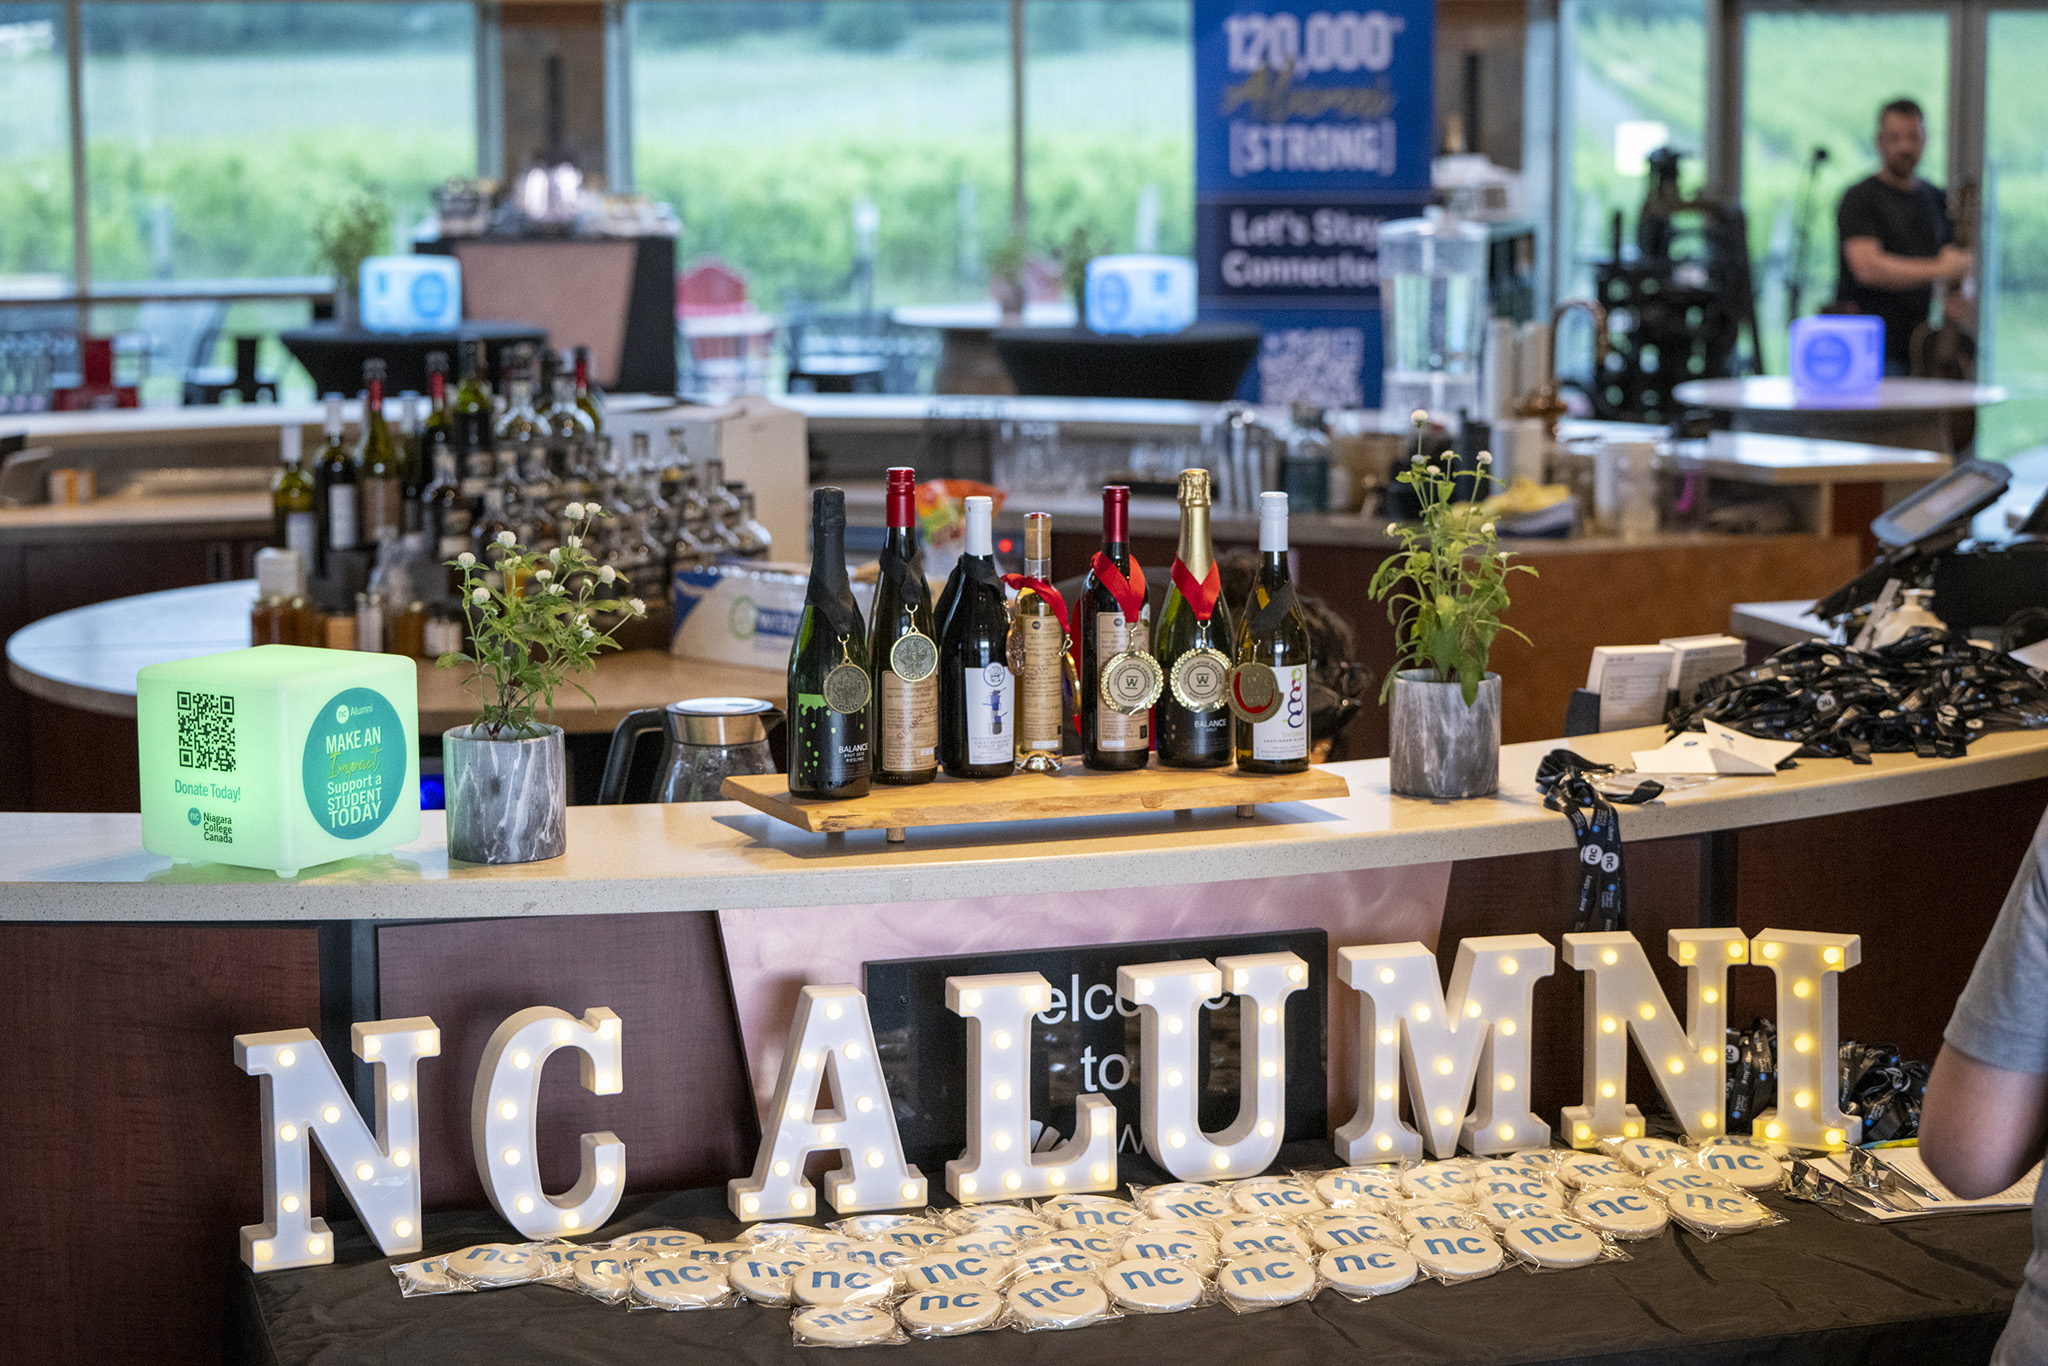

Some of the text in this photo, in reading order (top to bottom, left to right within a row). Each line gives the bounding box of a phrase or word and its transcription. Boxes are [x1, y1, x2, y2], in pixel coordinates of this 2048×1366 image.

[350, 704, 373, 716] Alumni
[1194, 718, 1227, 728] BALANCE
[326, 726, 381, 754] MAKE AN
[839, 742, 868, 754] BALANCE
[328, 747, 382, 779] Impact
[174, 779, 241, 803] Donate Today!
[328, 776, 382, 796] Support a
[327, 787, 382, 812] STUDENT
[203, 812, 232, 825] Niagara
[328, 801, 382, 829] TODAY
[203, 822, 233, 834] College
[204, 832, 233, 844] Canada
[1589, 847, 1597, 862] nc
[1606, 855, 1614, 869] nc
[1080, 1045, 1131, 1093] to
[234, 927, 1862, 1273] NC ALUMNI
[1572, 1160, 1623, 1177] nc
[1707, 1152, 1765, 1170] nc
[1334, 1177, 1390, 1199] nc
[1414, 1170, 1472, 1191] nc
[1488, 1182, 1548, 1199] nc
[1656, 1174, 1713, 1190] nc
[1250, 1188, 1310, 1207] nc
[1587, 1195, 1648, 1217] nc
[1686, 1193, 1743, 1213] nc
[1075, 1210, 1132, 1226] nc
[1165, 1199, 1224, 1219] nc
[1492, 1202, 1552, 1219] nc
[628, 1234, 687, 1247] nc
[1326, 1225, 1388, 1246] nc
[1520, 1223, 1582, 1246] nc
[957, 1240, 1014, 1257] nc
[1051, 1237, 1113, 1253] nc
[1136, 1242, 1198, 1261] nc
[1233, 1235, 1295, 1256] nc
[1423, 1235, 1486, 1255] nc
[466, 1247, 529, 1265] nc
[847, 1250, 906, 1268] nc
[1025, 1253, 1090, 1276] nc
[1333, 1252, 1396, 1273] nc
[645, 1265, 709, 1287] nc
[746, 1260, 806, 1278] nc
[920, 1257, 988, 1284] nc
[1120, 1267, 1184, 1290] nc
[1231, 1261, 1295, 1285] nc
[812, 1270, 872, 1289] nc
[919, 1292, 982, 1311] nc
[1017, 1280, 1086, 1308] nc
[812, 1308, 874, 1329] nc
